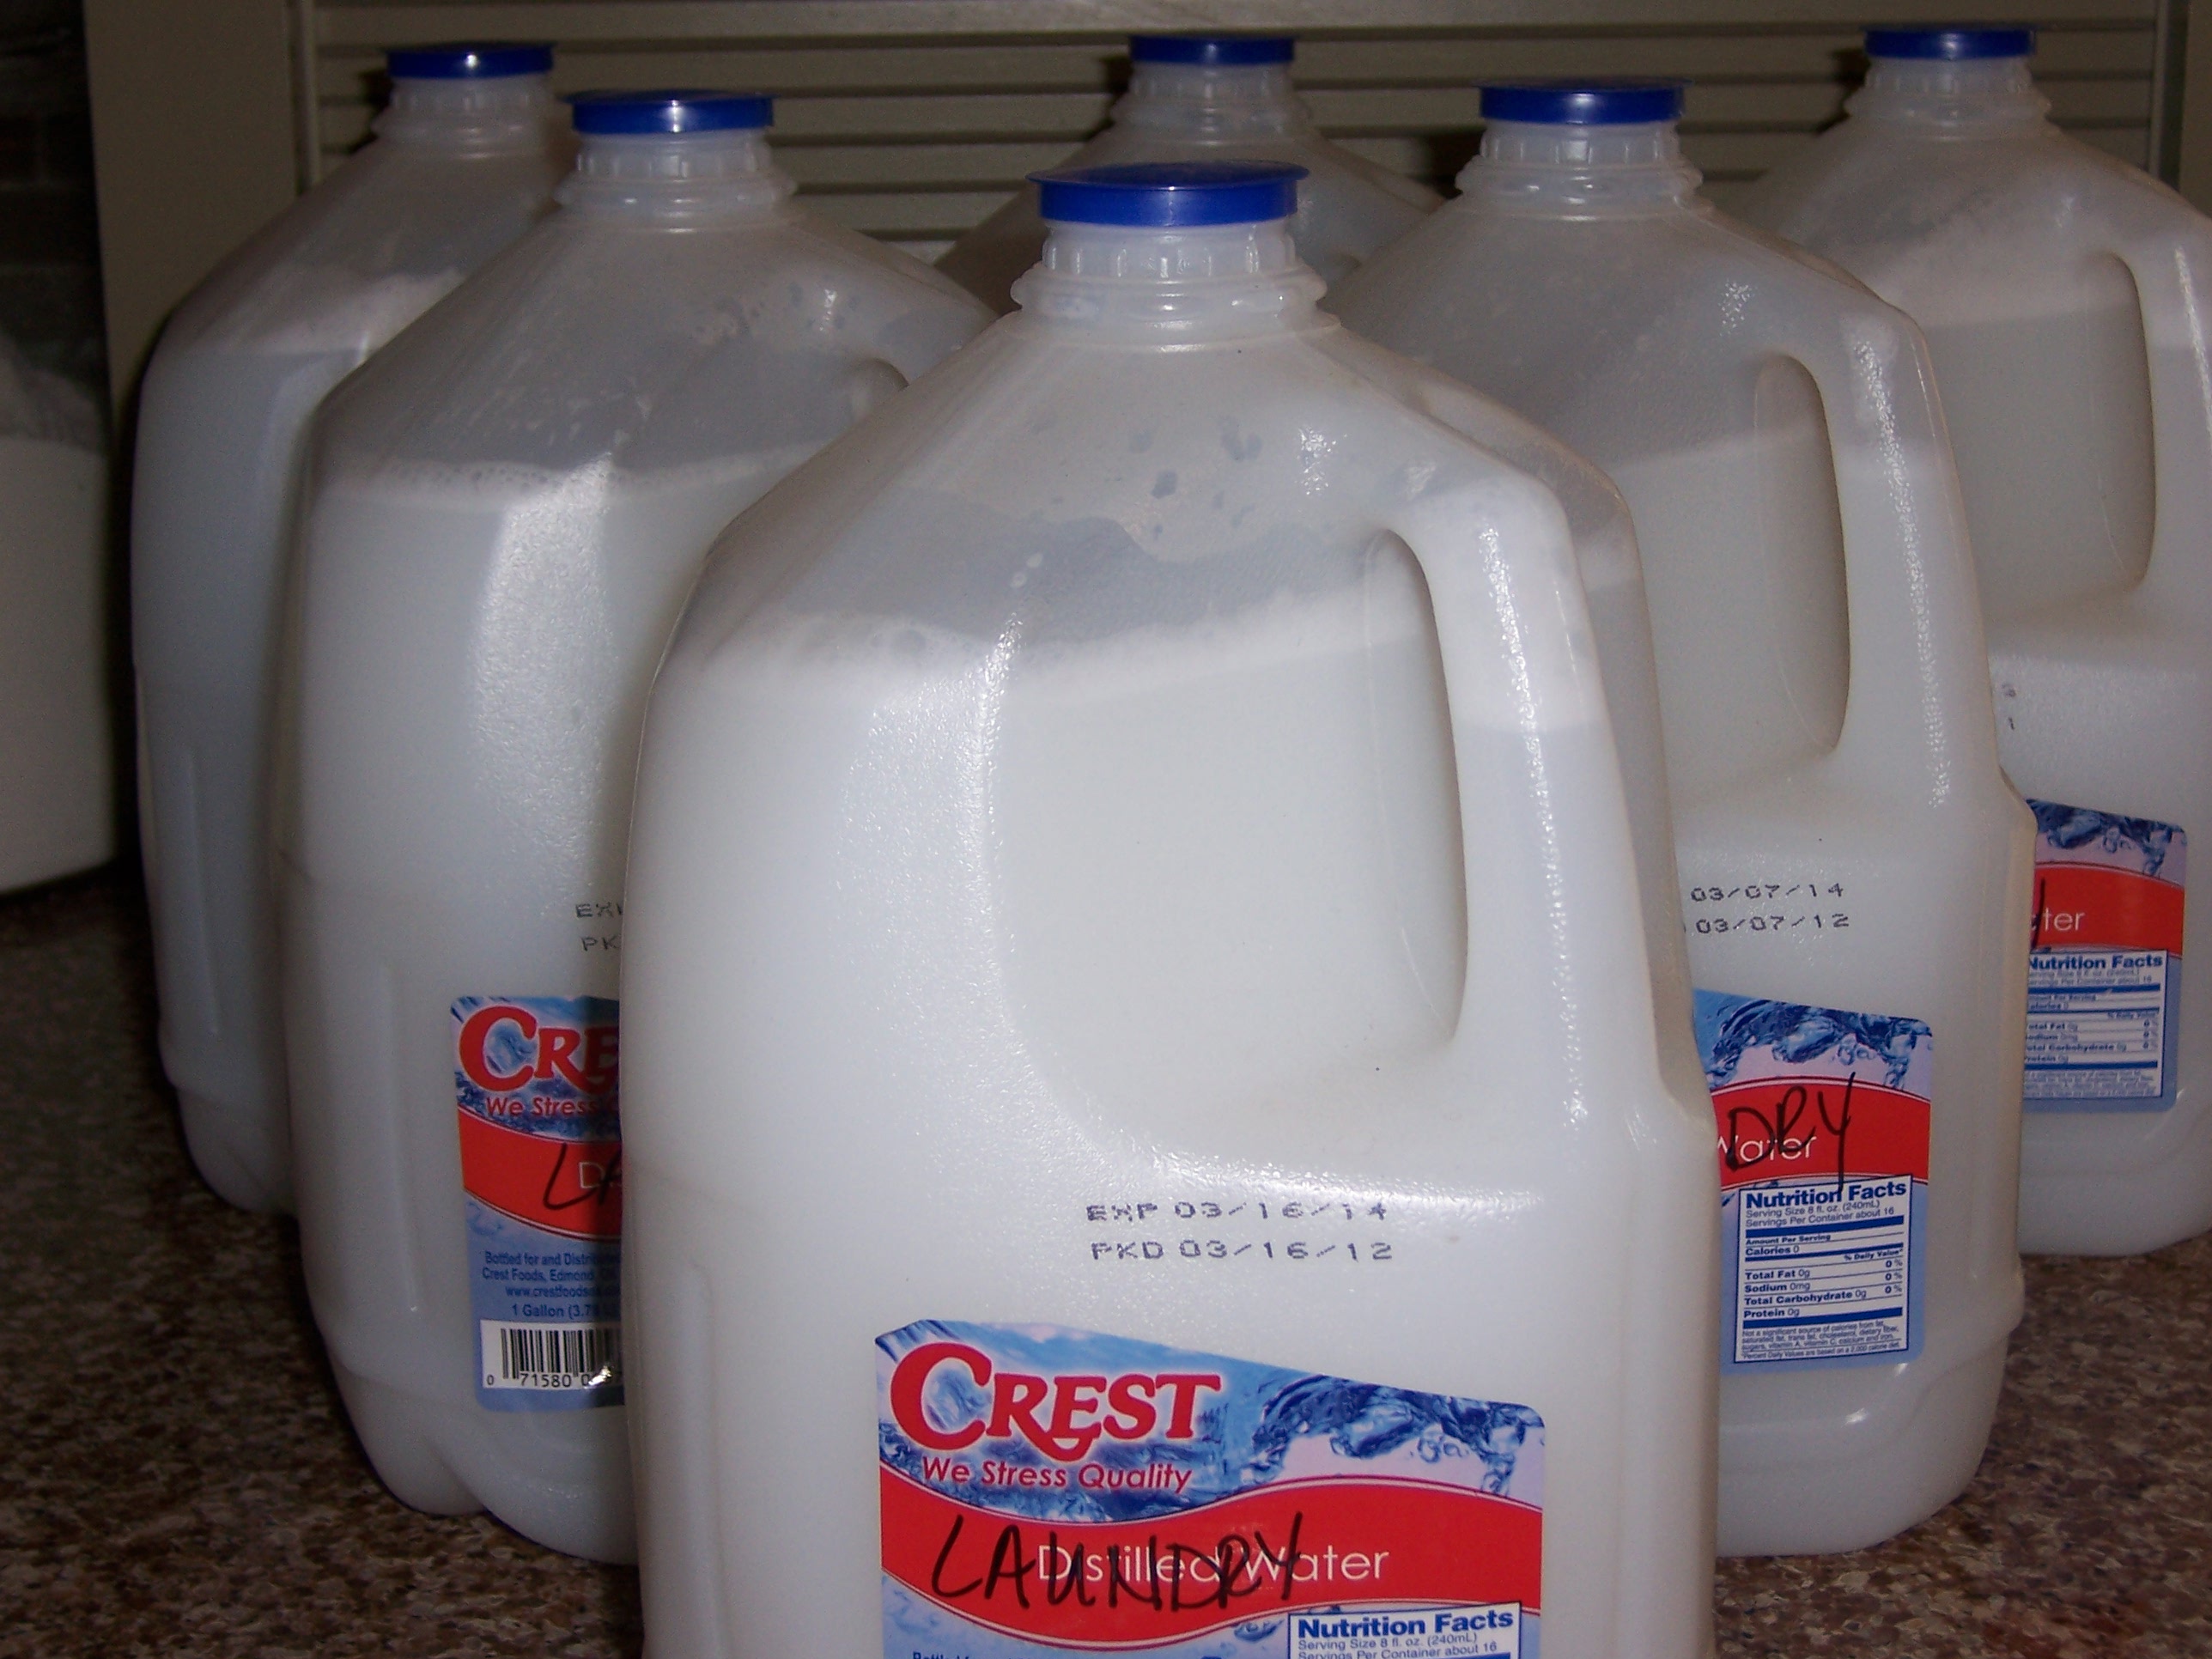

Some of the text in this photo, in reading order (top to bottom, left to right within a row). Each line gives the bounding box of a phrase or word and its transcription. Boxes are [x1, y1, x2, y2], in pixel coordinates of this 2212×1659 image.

[1691, 883, 1844, 902] 03/07/14
[575, 902, 623, 918] EX
[1696, 914, 1850, 934] 03/07/12
[2112, 955, 2163, 969] Facts
[486, 1097, 524, 1116] We
[532, 1097, 596, 1115] Stress
[1746, 1182, 1906, 1208] Nutrition Facts
[1086, 1202, 1158, 1221] EXP
[1746, 1209, 1782, 1218] Serving
[1785, 1206, 1805, 1215] Size
[1843, 1200, 1881, 1212] (240mL)
[1746, 1218, 1787, 1228] Servings
[1790, 1216, 1806, 1224] Per
[1808, 1212, 1853, 1223] Container
[1856, 1210, 1881, 1218] about
[1798, 1234, 1832, 1243] Serving
[485, 1250, 522, 1265] Bottled
[525, 1253, 538, 1266] for
[541, 1254, 561, 1266] and
[1091, 1240, 1392, 1261] PKD 03/16/12
[1745, 1247, 1791, 1256] Calories
[1853, 1251, 1875, 1261] Daily
[483, 1267, 509, 1281] Crest
[1745, 1271, 1774, 1280] Total
[1798, 1269, 1810, 1278] 0g
[1745, 1283, 1787, 1292] Sodium
[1790, 1282, 1810, 1291] 0mg
[1744, 1297, 1772, 1305] Total
[1776, 1291, 1852, 1304] Carbohydrate
[1855, 1290, 1867, 1299] 0g
[512, 1304, 518, 1316] 1
[522, 1304, 564, 1317] Gallon
[1744, 1308, 1800, 1318] Protein 0g
[486, 1375, 495, 1386] 0
[520, 1373, 572, 1388] 71580
[922, 1456, 1194, 1494] We Stress Quality
[931, 1511, 1303, 1613] LAUNDRY
[1241, 1545, 1389, 1582] Water
[1298, 1610, 1514, 1638] Nutrition Facts
[1298, 1632, 1477, 1650] Serving Size 8 fl. oz. (240mL)
[1298, 1641, 1497, 1659] Servings Per Container about 16
